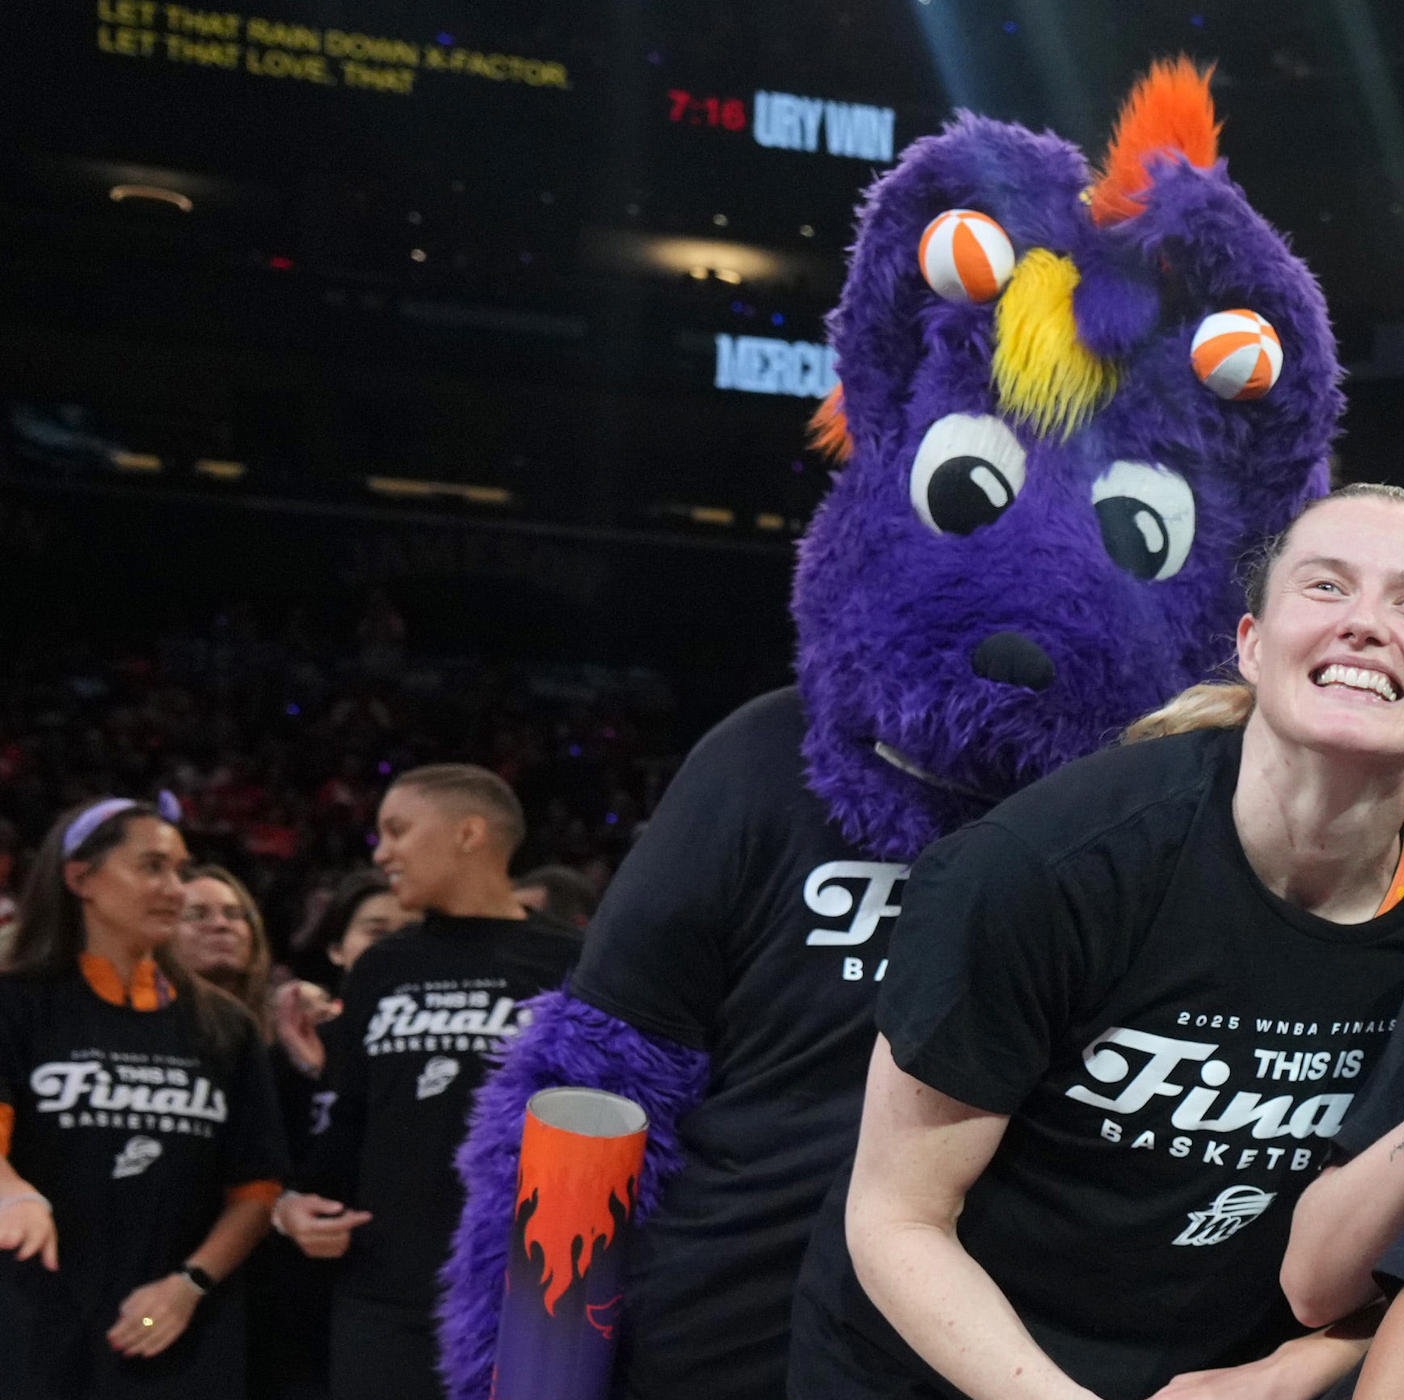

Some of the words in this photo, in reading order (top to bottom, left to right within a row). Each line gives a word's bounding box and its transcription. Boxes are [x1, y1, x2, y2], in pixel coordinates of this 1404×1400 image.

[825, 100, 895, 162] WIN
[714, 332, 841, 398] MERCU
[1177, 1011, 1241, 1031] 2025
[1255, 1018, 1319, 1037] WNBA
[1331, 1019, 1397, 1036] FINALS
[30, 1061, 228, 1123] Finals
[1065, 1026, 1355, 1140] Fina
[1253, 1048, 1331, 1081] THIS
[1332, 1049, 1365, 1080] IS
[1100, 1118, 1318, 1171] BASKETB
